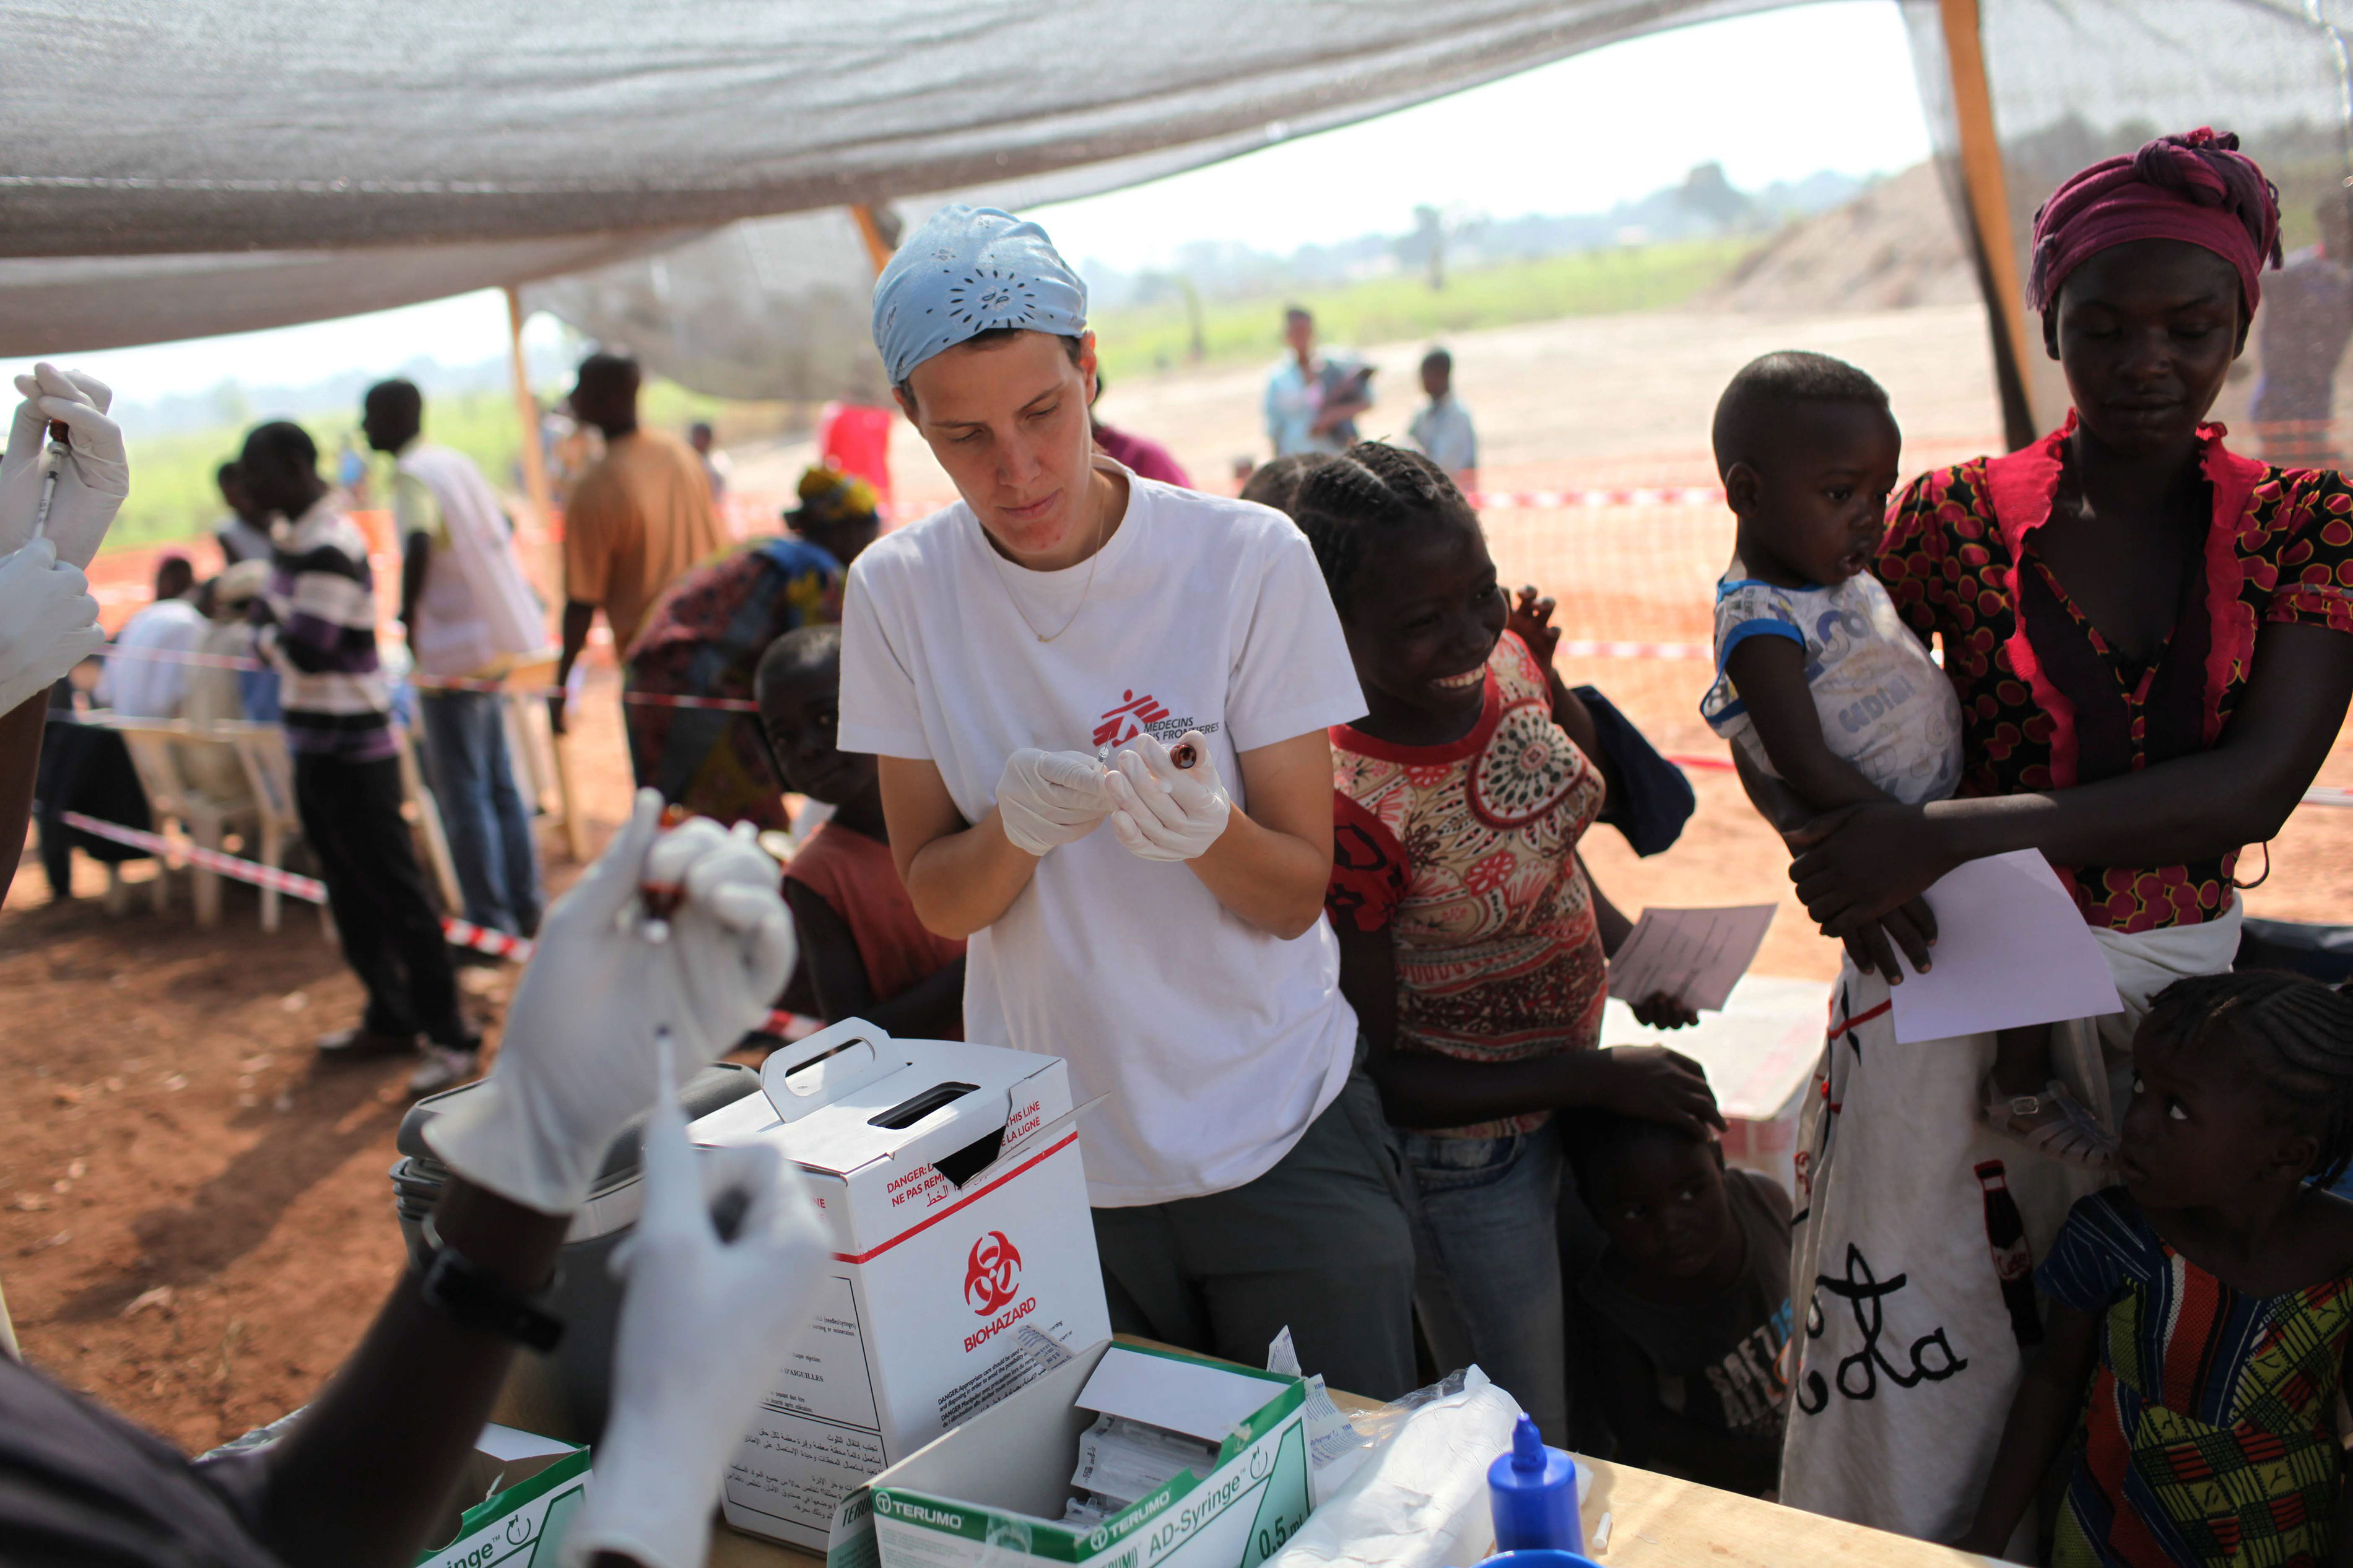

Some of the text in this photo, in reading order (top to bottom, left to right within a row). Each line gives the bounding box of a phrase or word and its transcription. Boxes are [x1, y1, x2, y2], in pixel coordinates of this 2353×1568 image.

[1144, 717, 1193, 732] MEDECINS
[1023, 1101, 1040, 1117] LINE
[1007, 1130, 1017, 1143] LA
[1018, 1116, 1040, 1137] LIGNE
[887, 1167, 927, 1193] DANGER:
[892, 1193, 905, 1208] NE
[907, 1184, 923, 1200] PAS
[964, 1297, 1036, 1353] BIOHAZARD
[784, 1367, 824, 1382] D'AIGUILLES
[892, 1500, 962, 1530] TERUMO
[1108, 1489, 1170, 1538] TERUMO
